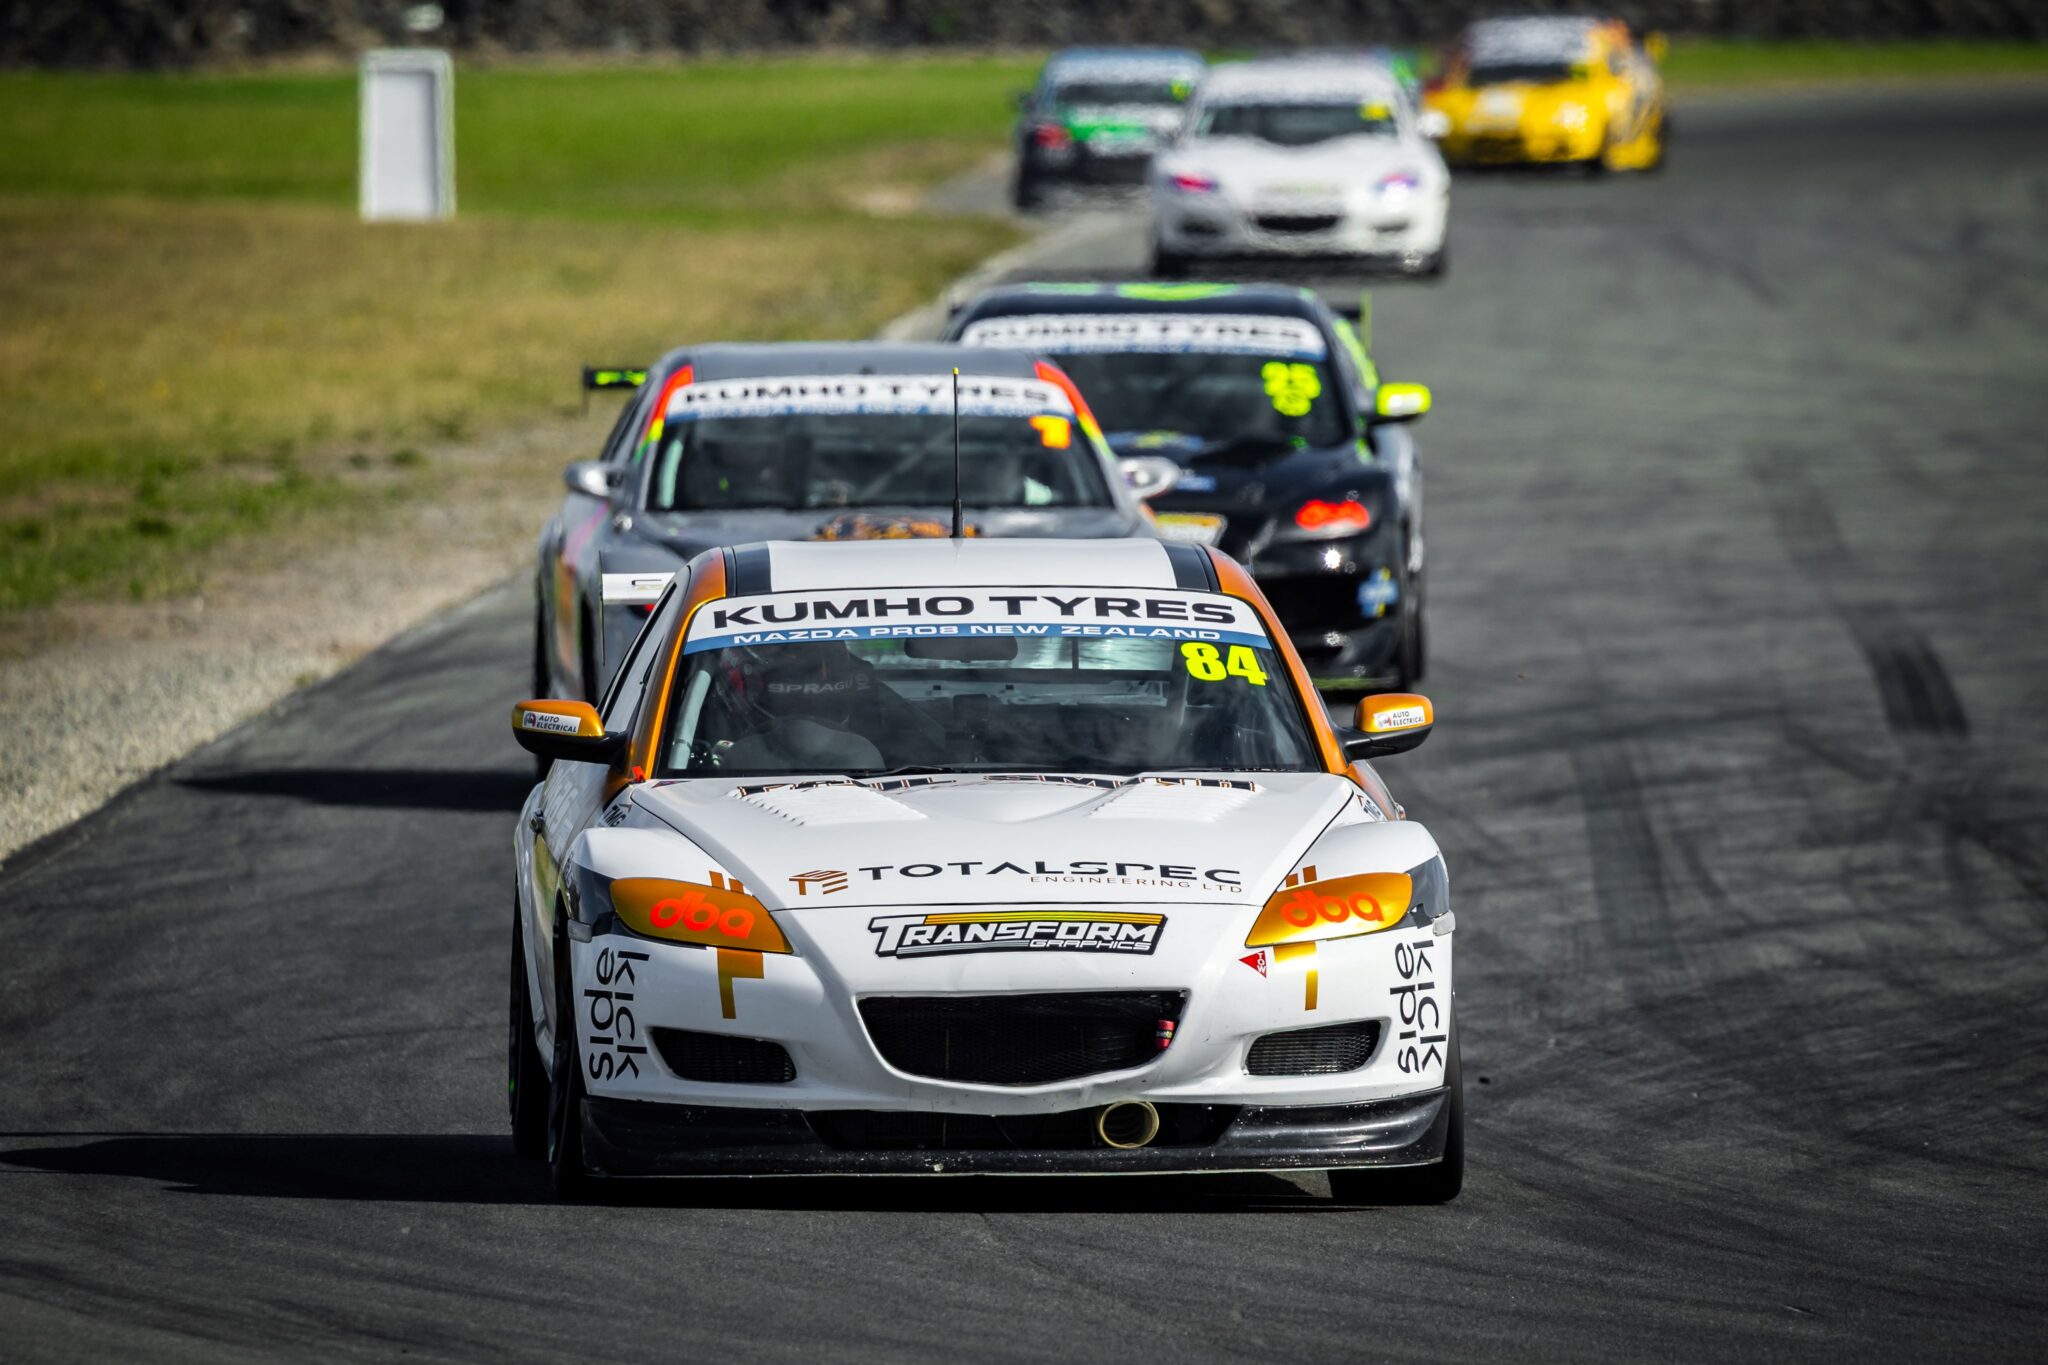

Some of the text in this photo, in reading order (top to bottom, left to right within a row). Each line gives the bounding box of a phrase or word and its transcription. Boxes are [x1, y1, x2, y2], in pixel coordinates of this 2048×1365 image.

[685, 383, 867, 402] KUMHO
[713, 595, 1236, 629] KUMHO TYRES
[733, 627, 859, 645] MAZDA
[970, 624, 1049, 635] NEW
[1060, 625, 1221, 641] ZEALAND
[1180, 641, 1269, 687] 84
[538, 715, 561, 724] AUTO
[1392, 710, 1411, 719] AUTO
[1392, 716, 1424, 727] ELECTRICAL
[536, 721, 577, 733] ELECTRICAL
[858, 860, 1242, 886] TOTALSPEC
[1030, 875, 1243, 894] ENGINEERING LTD
[650, 889, 757, 939] dba
[1280, 888, 1385, 928] dba
[870, 914, 1159, 953] TRANSFORM
[1028, 938, 1153, 951] GRAPHICS
[1257, 951, 1267, 974] TOW
